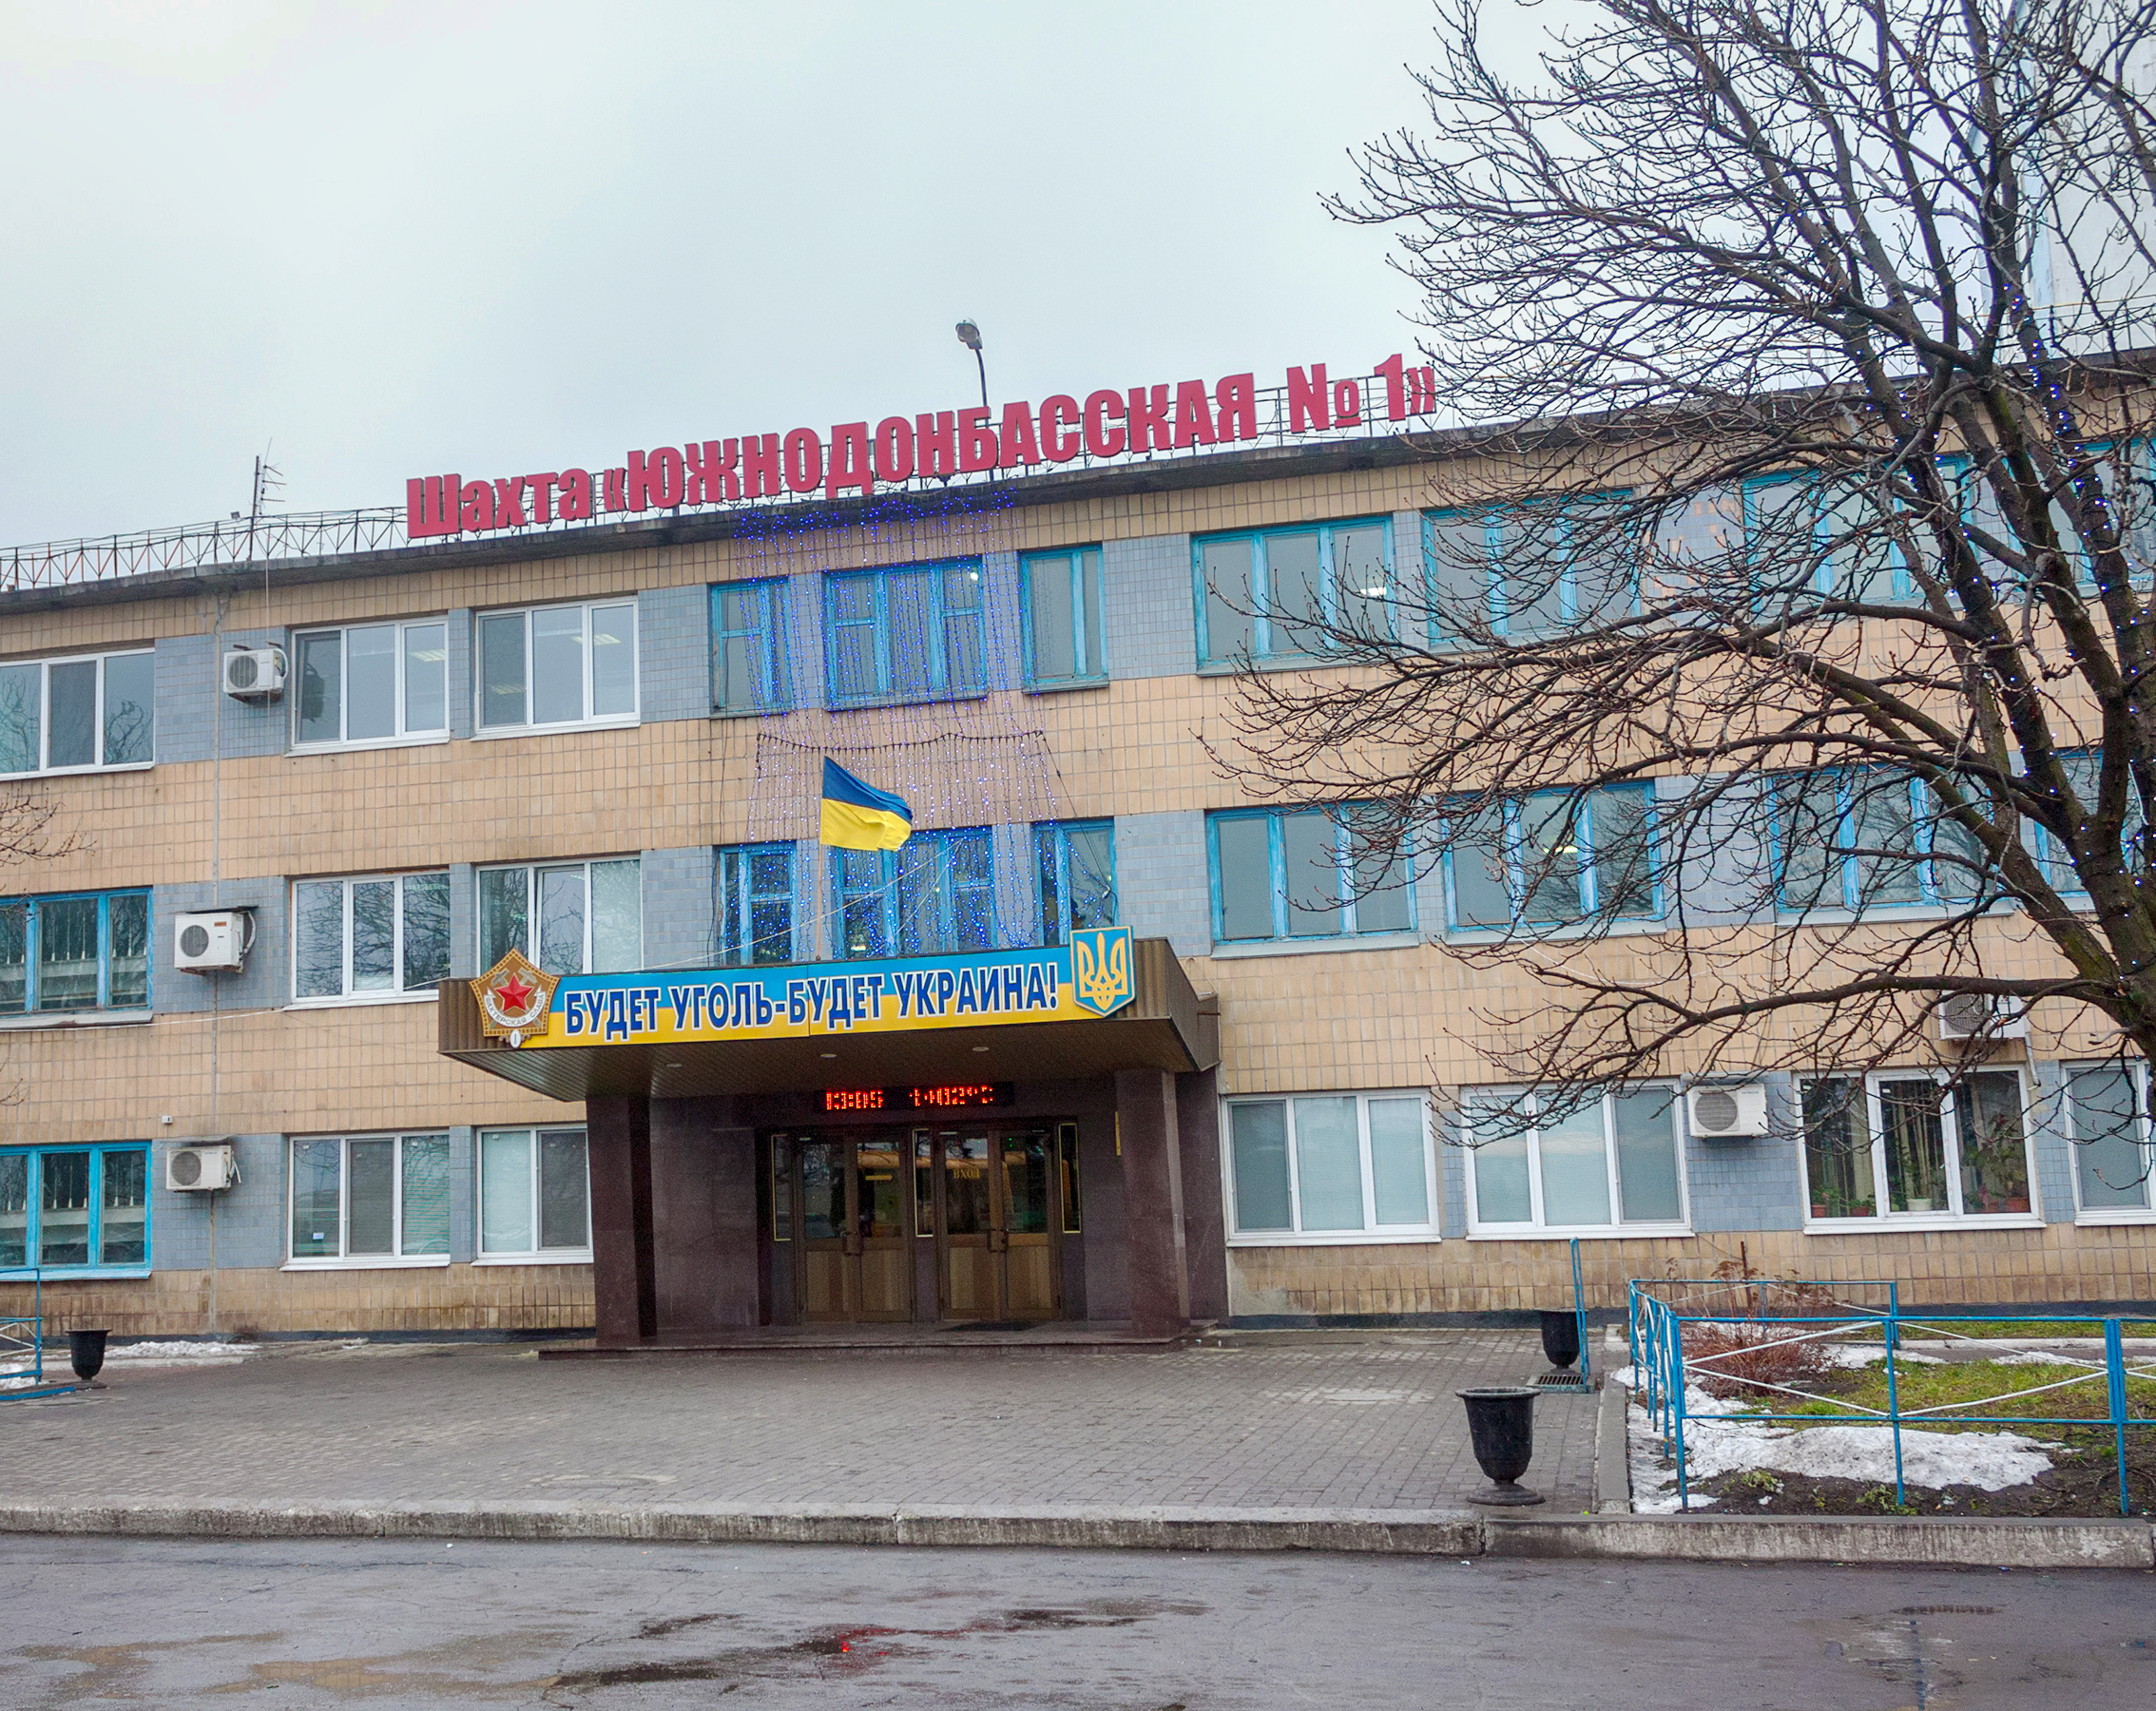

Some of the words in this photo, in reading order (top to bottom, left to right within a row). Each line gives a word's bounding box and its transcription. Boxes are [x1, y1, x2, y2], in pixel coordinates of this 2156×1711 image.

[406, 469, 591, 539] Шахта
[603, 373, 1259, 511] «ЮЖНОДОНБАССКАЯ
[485, 996, 527, 1025] ШАХТЕРСКАЯ
[529, 993, 545, 1018] СЛАВА
[565, 988, 661, 1041] БУДЕТ
[893, 962, 1058, 1018] УКРАИНА!
